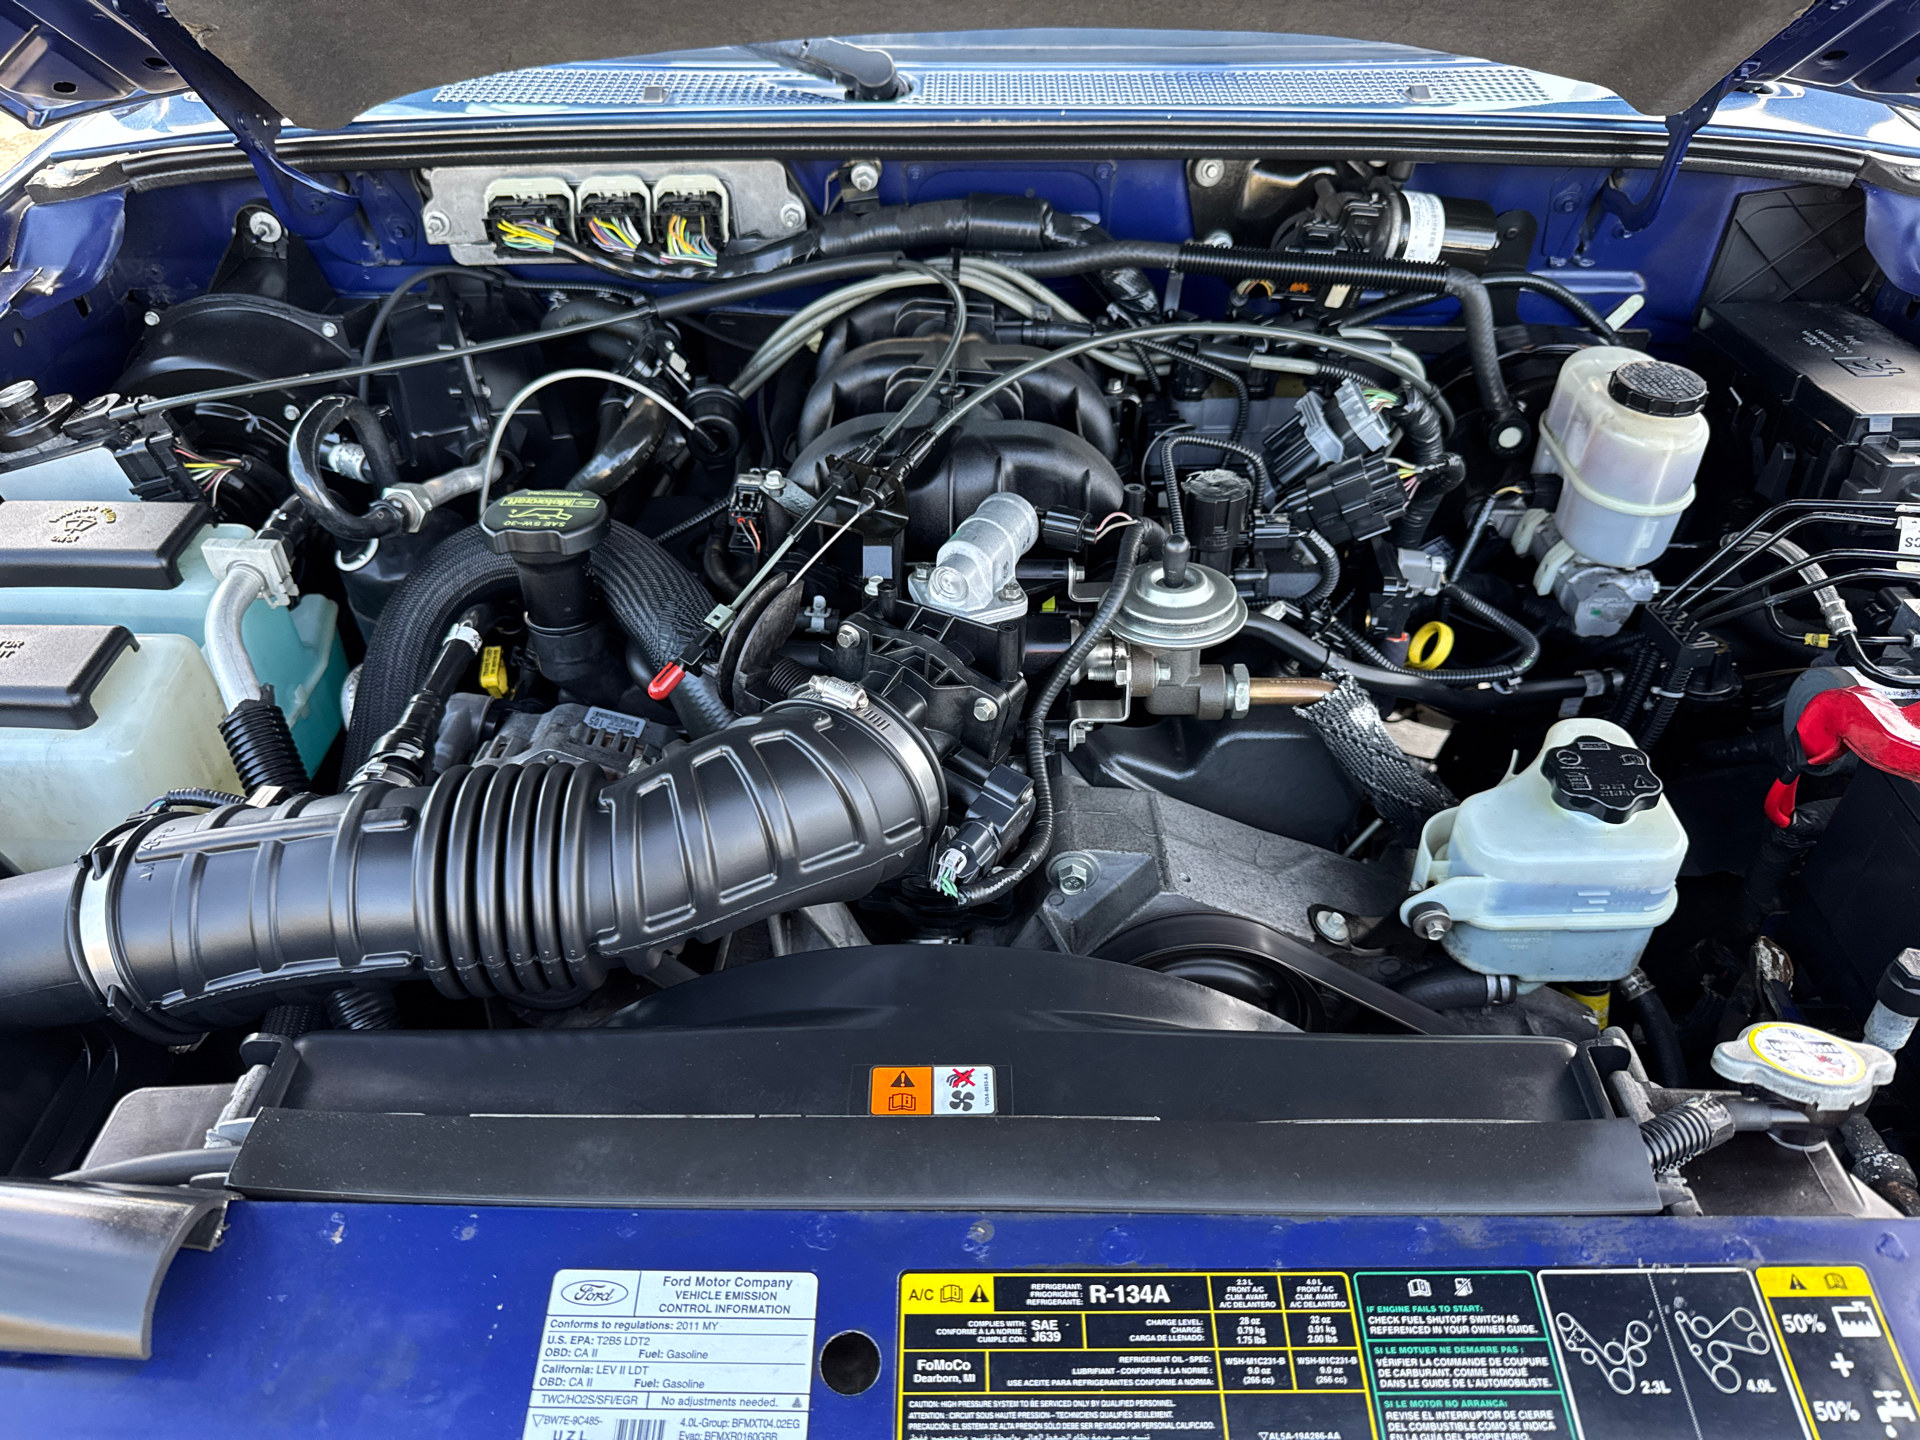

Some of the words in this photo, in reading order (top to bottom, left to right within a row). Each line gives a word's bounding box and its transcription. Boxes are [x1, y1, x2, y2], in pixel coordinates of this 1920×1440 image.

[588, 716, 604, 728] 105
[663, 1276, 691, 1286] Ford
[695, 1276, 731, 1287] Motor
[735, 1277, 792, 1290] Company
[574, 1284, 612, 1302] Ford
[676, 1291, 721, 1300] VEHICLE
[725, 1291, 777, 1300] EMISSION
[909, 1289, 934, 1301] A/C
[1090, 1285, 1170, 1303] R-134A
[659, 1304, 711, 1313] CONTROL
[715, 1304, 790, 1314] INFORMATION
[1239, 1317, 1250, 1325] 28
[1310, 1315, 1320, 1324] 32
[1368, 1316, 1400, 1324] CHECK
[1401, 1316, 1425, 1324] FUEL
[1426, 1315, 1467, 1324] SHUTOFF
[1469, 1315, 1505, 1324] SWITCH
[1506, 1315, 1519, 1324] AS
[1782, 1314, 1826, 1333] 50%
[550, 1319, 598, 1328] Conforms
[602, 1321, 612, 1329] to
[614, 1321, 673, 1331] regulations:
[676, 1321, 698, 1330] 2011
[703, 1322, 719, 1330] MY
[1031, 1320, 1058, 1330] SAE
[1308, 1325, 1324, 1335] 0.91
[1326, 1325, 1336, 1335] kg
[1370, 1326, 1431, 1334] REFERENCED
[1432, 1326, 1442, 1334] IN
[1444, 1325, 1469, 1334] YOUR
[1471, 1325, 1505, 1334] OWNER
[1507, 1325, 1538, 1334] GUIDE.
[1237, 1326, 1254, 1336] 0.79
[1255, 1326, 1265, 1336] kg
[547, 1335, 566, 1344] U.S.
[570, 1336, 594, 1345] EPA:
[597, 1336, 621, 1345] T2B5
[624, 1336, 650, 1346] LDT2
[1032, 1331, 1061, 1342] J639
[1236, 1336, 1253, 1344] 1.75
[1254, 1335, 1267, 1344] lbs
[1307, 1335, 1324, 1343] 2.00
[1325, 1334, 1338, 1343] lbs
[545, 1348, 571, 1357] OBD:
[574, 1348, 588, 1357] CA
[592, 1348, 598, 1357] II
[638, 1349, 663, 1358] Fuel:
[667, 1350, 708, 1359] Gasoline
[917, 1359, 971, 1371] FoMoCo
[1376, 1357, 1418, 1367] VÉRIFIER
[1419, 1358, 1432, 1367] LA
[1433, 1358, 1487, 1366] COMMANDE
[1488, 1357, 1502, 1366] DE
[1503, 1357, 1548, 1366] COUPURE
[542, 1364, 593, 1374] California:
[596, 1365, 617, 1374] LEV
[619, 1366, 626, 1374] II
[628, 1366, 649, 1375] LDT
[1378, 1369, 1391, 1377] DE
[1453, 1368, 1488, 1377] COMME
[539, 1377, 566, 1386] OBD:
[569, 1377, 583, 1387] CA
[586, 1378, 593, 1387] II
[634, 1378, 659, 1388] Fuel:
[662, 1379, 704, 1388] Gasoline
[914, 1374, 961, 1383] Dearborn,
[963, 1374, 976, 1382] MI
[1380, 1379, 1406, 1388] DANS
[1408, 1379, 1420, 1388] LE
[1422, 1379, 1451, 1388] GUIDE
[1452, 1379, 1466, 1388] DE
[1640, 1380, 1671, 1394] 2.3L
[661, 1396, 675, 1405] No
[678, 1397, 736, 1406] adjustments
[740, 1398, 778, 1407] needed.
[1395, 1400, 1407, 1408] LE
[1386, 1411, 1420, 1420] REVISE
[1422, 1411, 1434, 1420] EL
[1436, 1411, 1501, 1420] INTERRUPTOR
[1503, 1410, 1517, 1420] DE
[1518, 1410, 1554, 1420] CIERRE
[1814, 1401, 1860, 1421] 50%
[1388, 1422, 1407, 1432] DEL
[1409, 1422, 1476, 1431] COMBUSTIBLE
[1478, 1422, 1507, 1431] COMO
[1508, 1422, 1521, 1431] SE
[1523, 1421, 1556, 1431] INDICA
